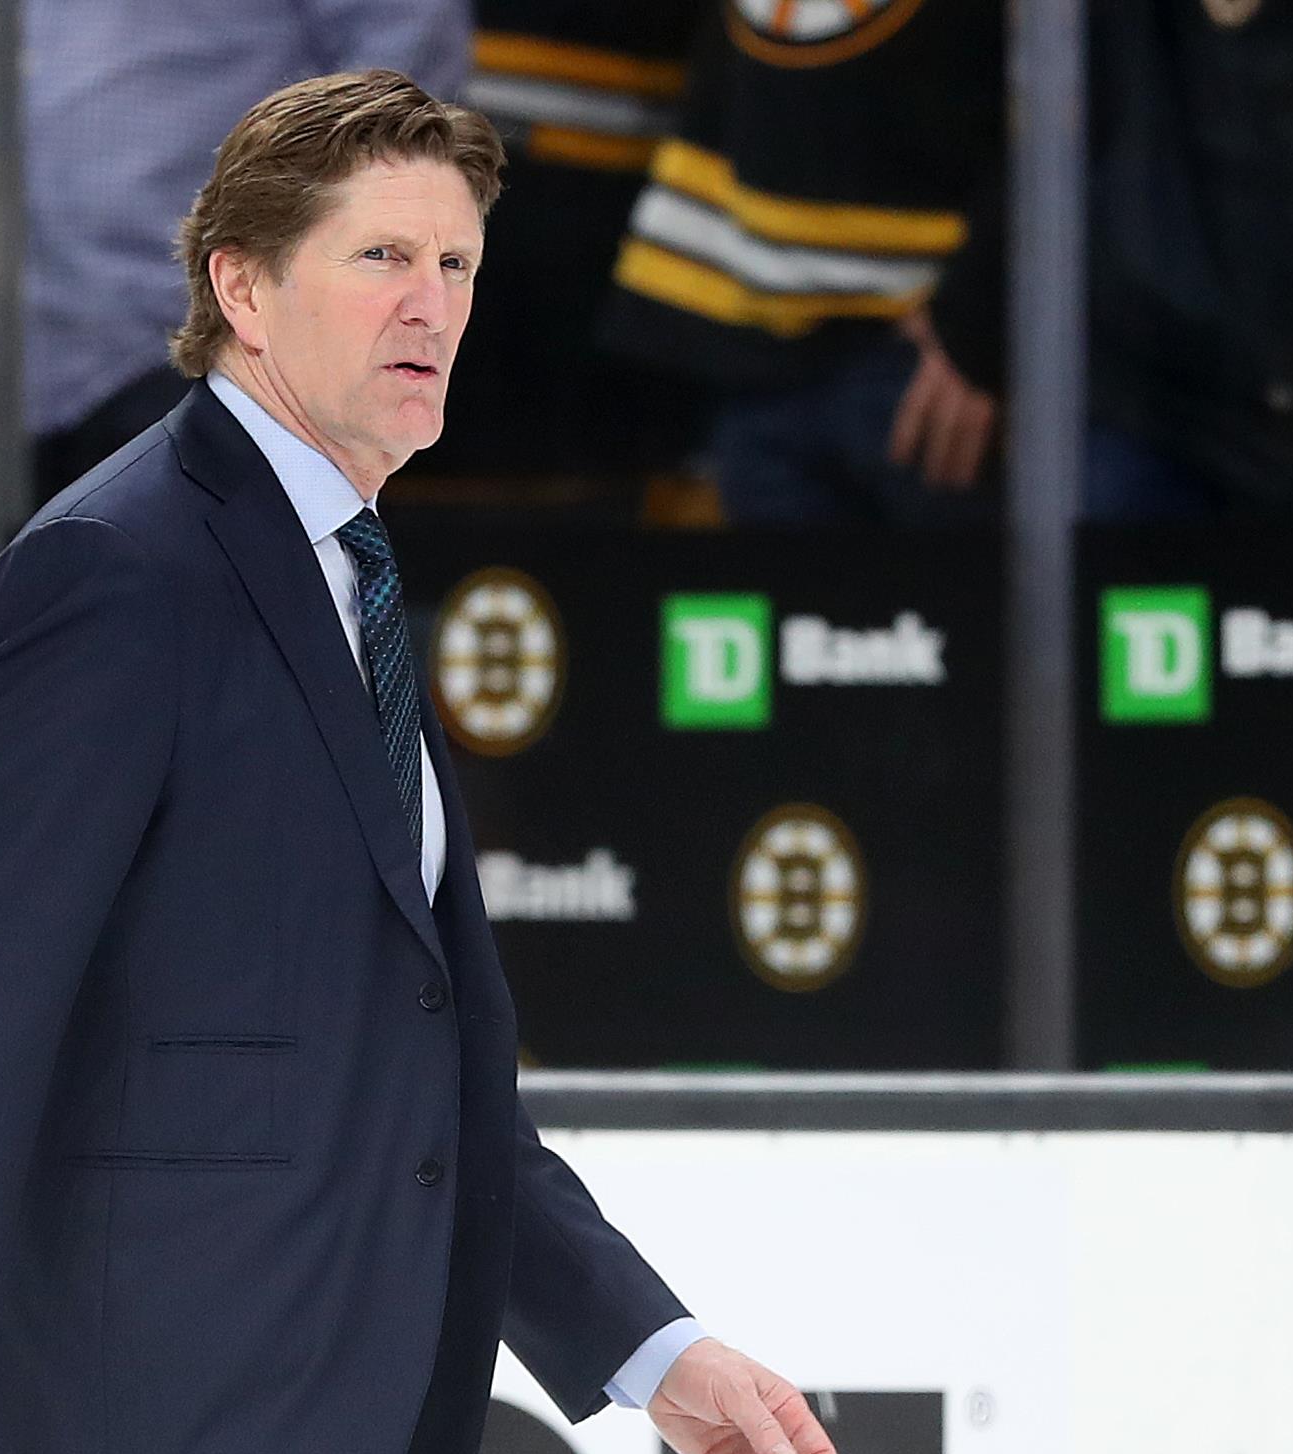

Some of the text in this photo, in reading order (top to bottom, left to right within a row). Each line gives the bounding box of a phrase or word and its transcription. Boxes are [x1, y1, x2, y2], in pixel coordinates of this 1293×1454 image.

[667, 611, 947, 706] TD Bank
[1107, 607, 1204, 699] TD
[477, 849, 635, 921] Bank
